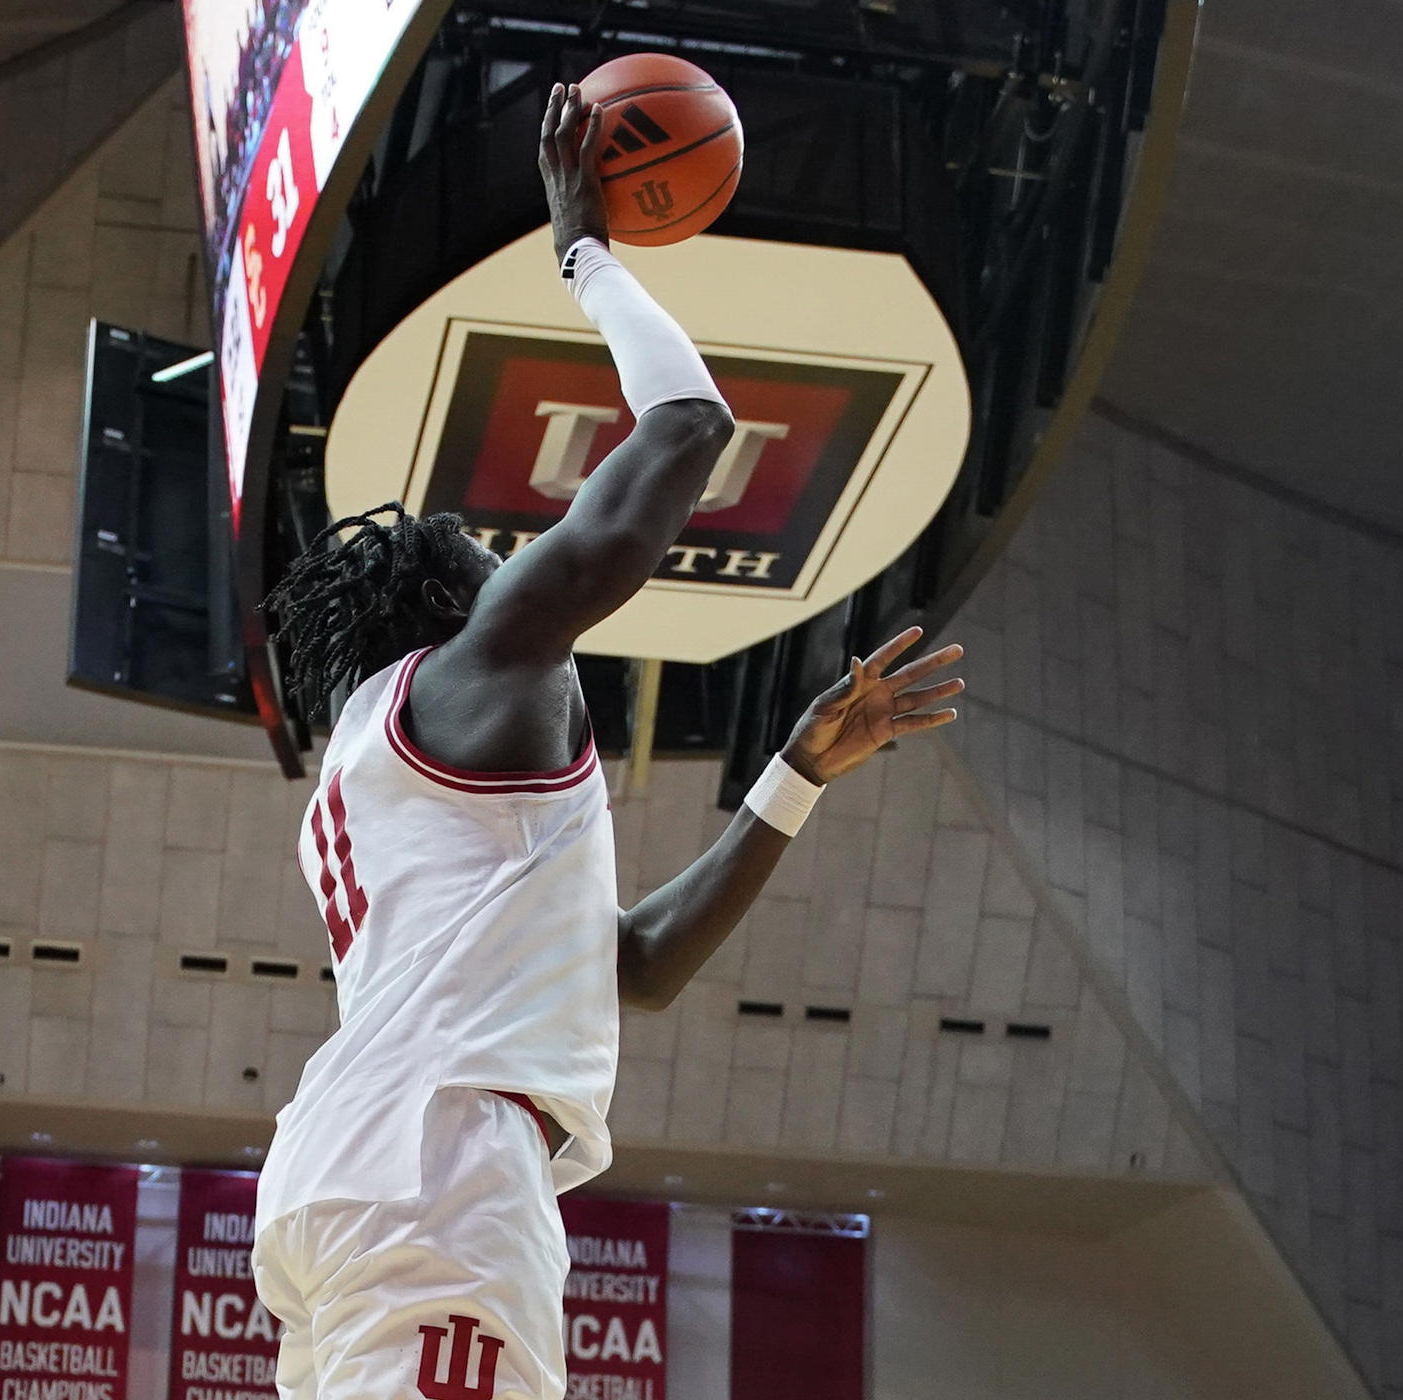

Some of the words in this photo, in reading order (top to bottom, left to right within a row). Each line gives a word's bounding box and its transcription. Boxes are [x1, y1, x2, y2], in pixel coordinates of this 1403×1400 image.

[22, 1199, 114, 1234] INDIANA
[6, 1234, 126, 1272] UNIVERSITY
[565, 1235, 647, 1269] NDIANA
[180, 1289, 286, 1343] NCA
[563, 1313, 662, 1364] CAA
[181, 1349, 276, 1387] BASKETBA
